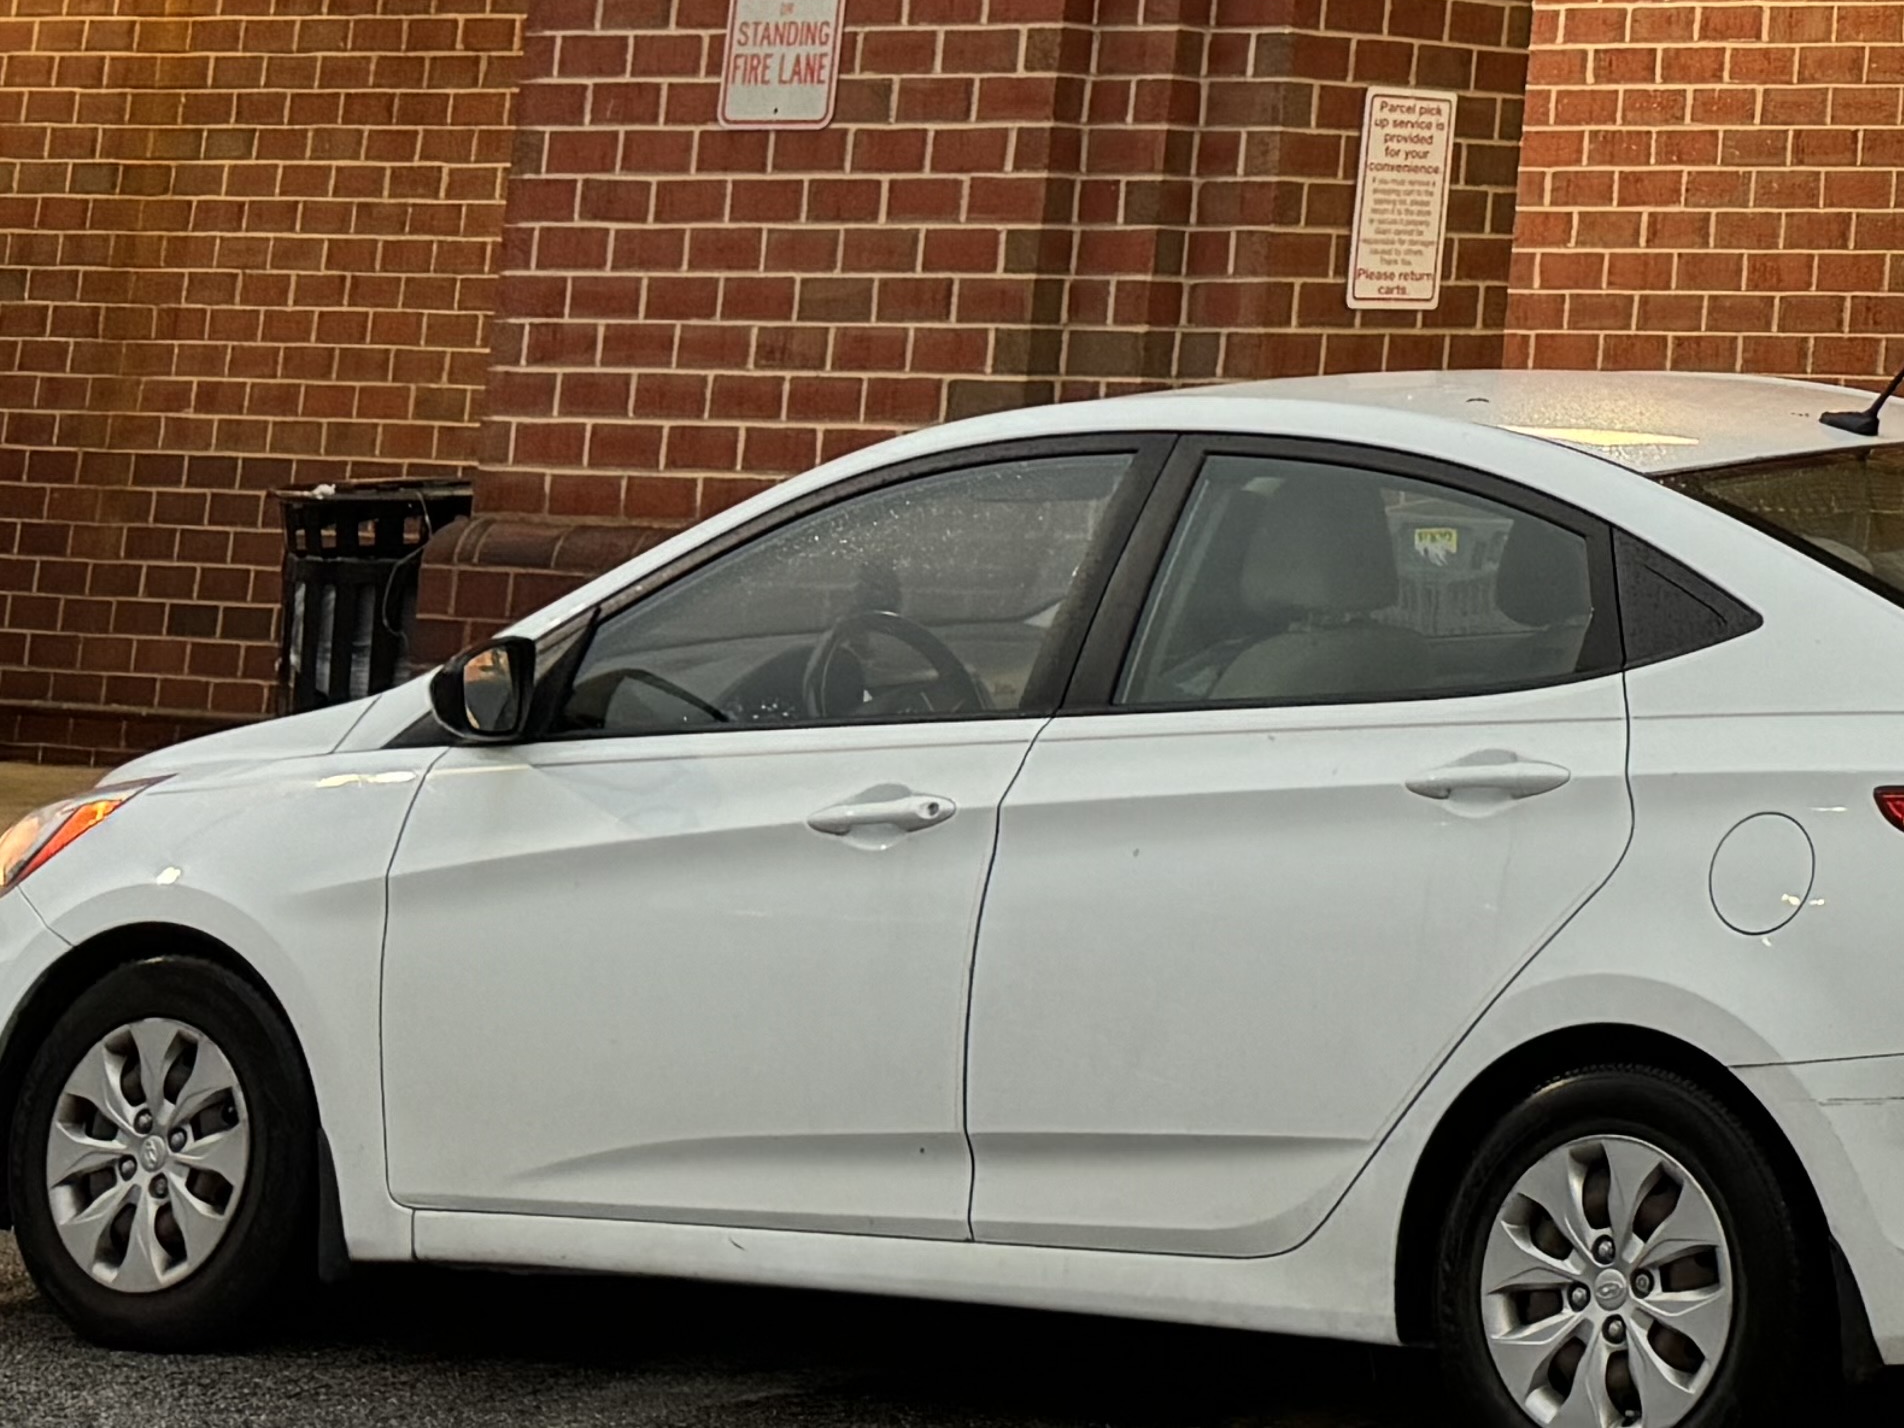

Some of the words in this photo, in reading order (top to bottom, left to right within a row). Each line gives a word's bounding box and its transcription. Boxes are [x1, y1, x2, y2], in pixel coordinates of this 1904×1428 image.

[737, 21, 831, 47] STANDING
[731, 53, 773, 85] FIRE
[778, 53, 828, 85] LANE
[1379, 100, 1417, 116] Parcel
[1419, 103, 1443, 120] pick
[1392, 118, 1432, 131] service
[1383, 131, 1434, 147] provided
[1384, 145, 1401, 159] for
[1404, 149, 1430, 163] your
[1357, 267, 1395, 282] Please
[1398, 269, 1433, 283] return
